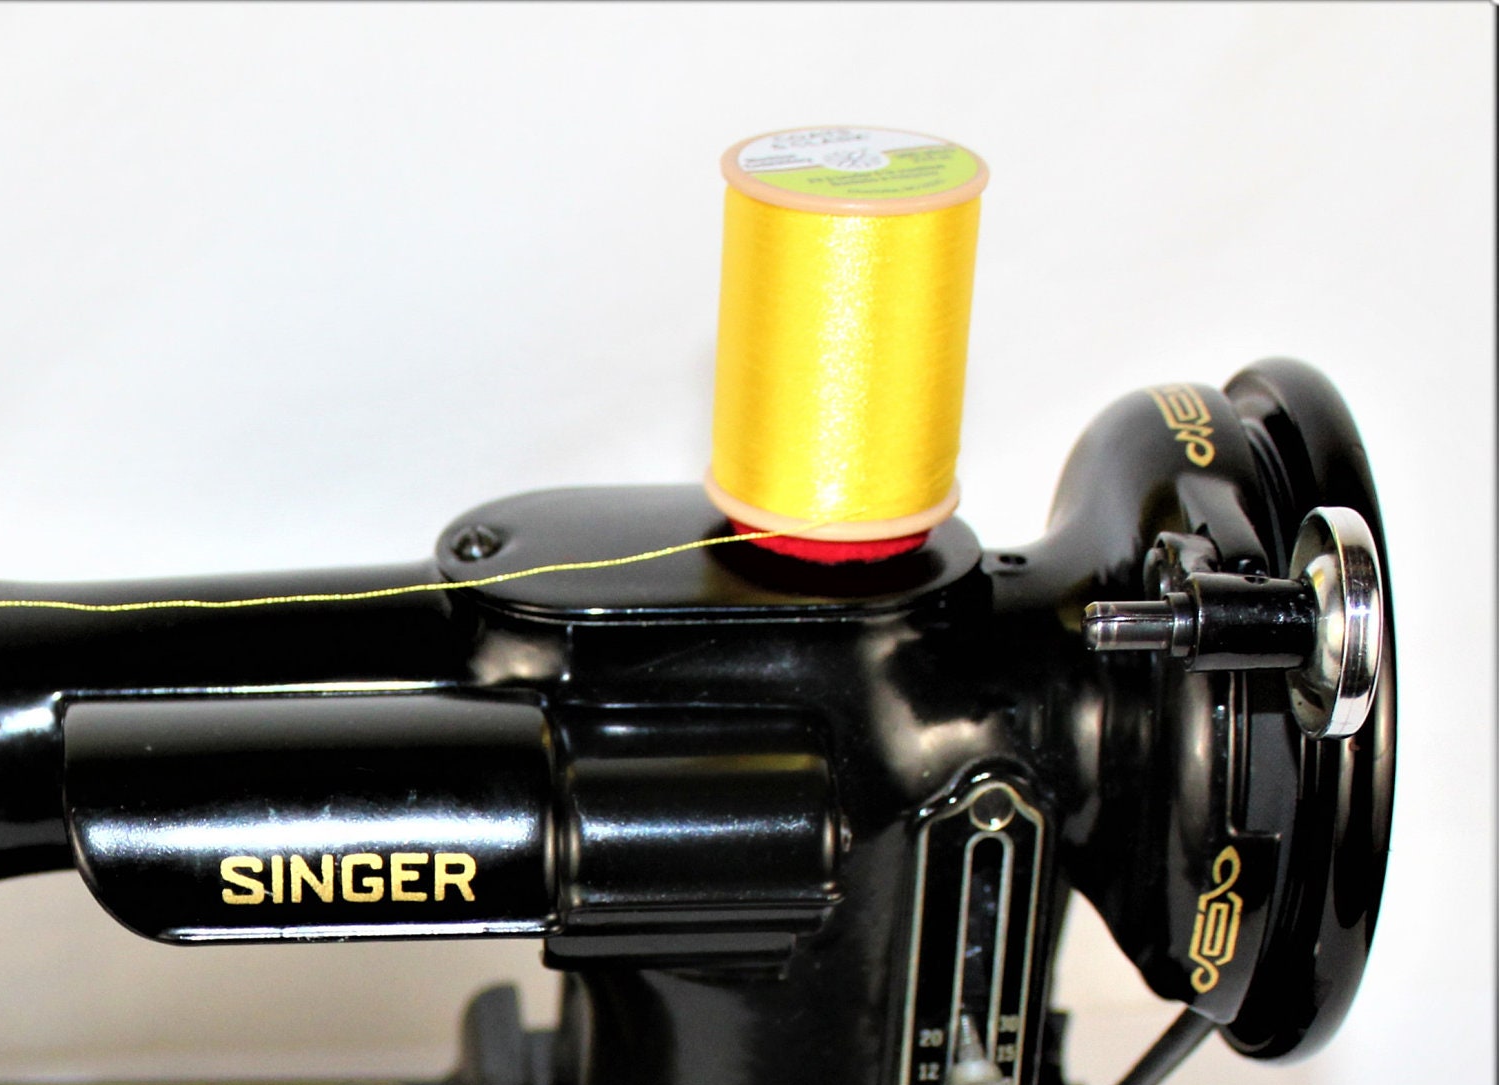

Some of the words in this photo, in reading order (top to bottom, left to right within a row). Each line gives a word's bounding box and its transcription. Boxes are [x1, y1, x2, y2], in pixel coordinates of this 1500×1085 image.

[220, 852, 477, 905] SINGER
[918, 1028, 944, 1048] 20
[918, 1063, 940, 1081] 12
